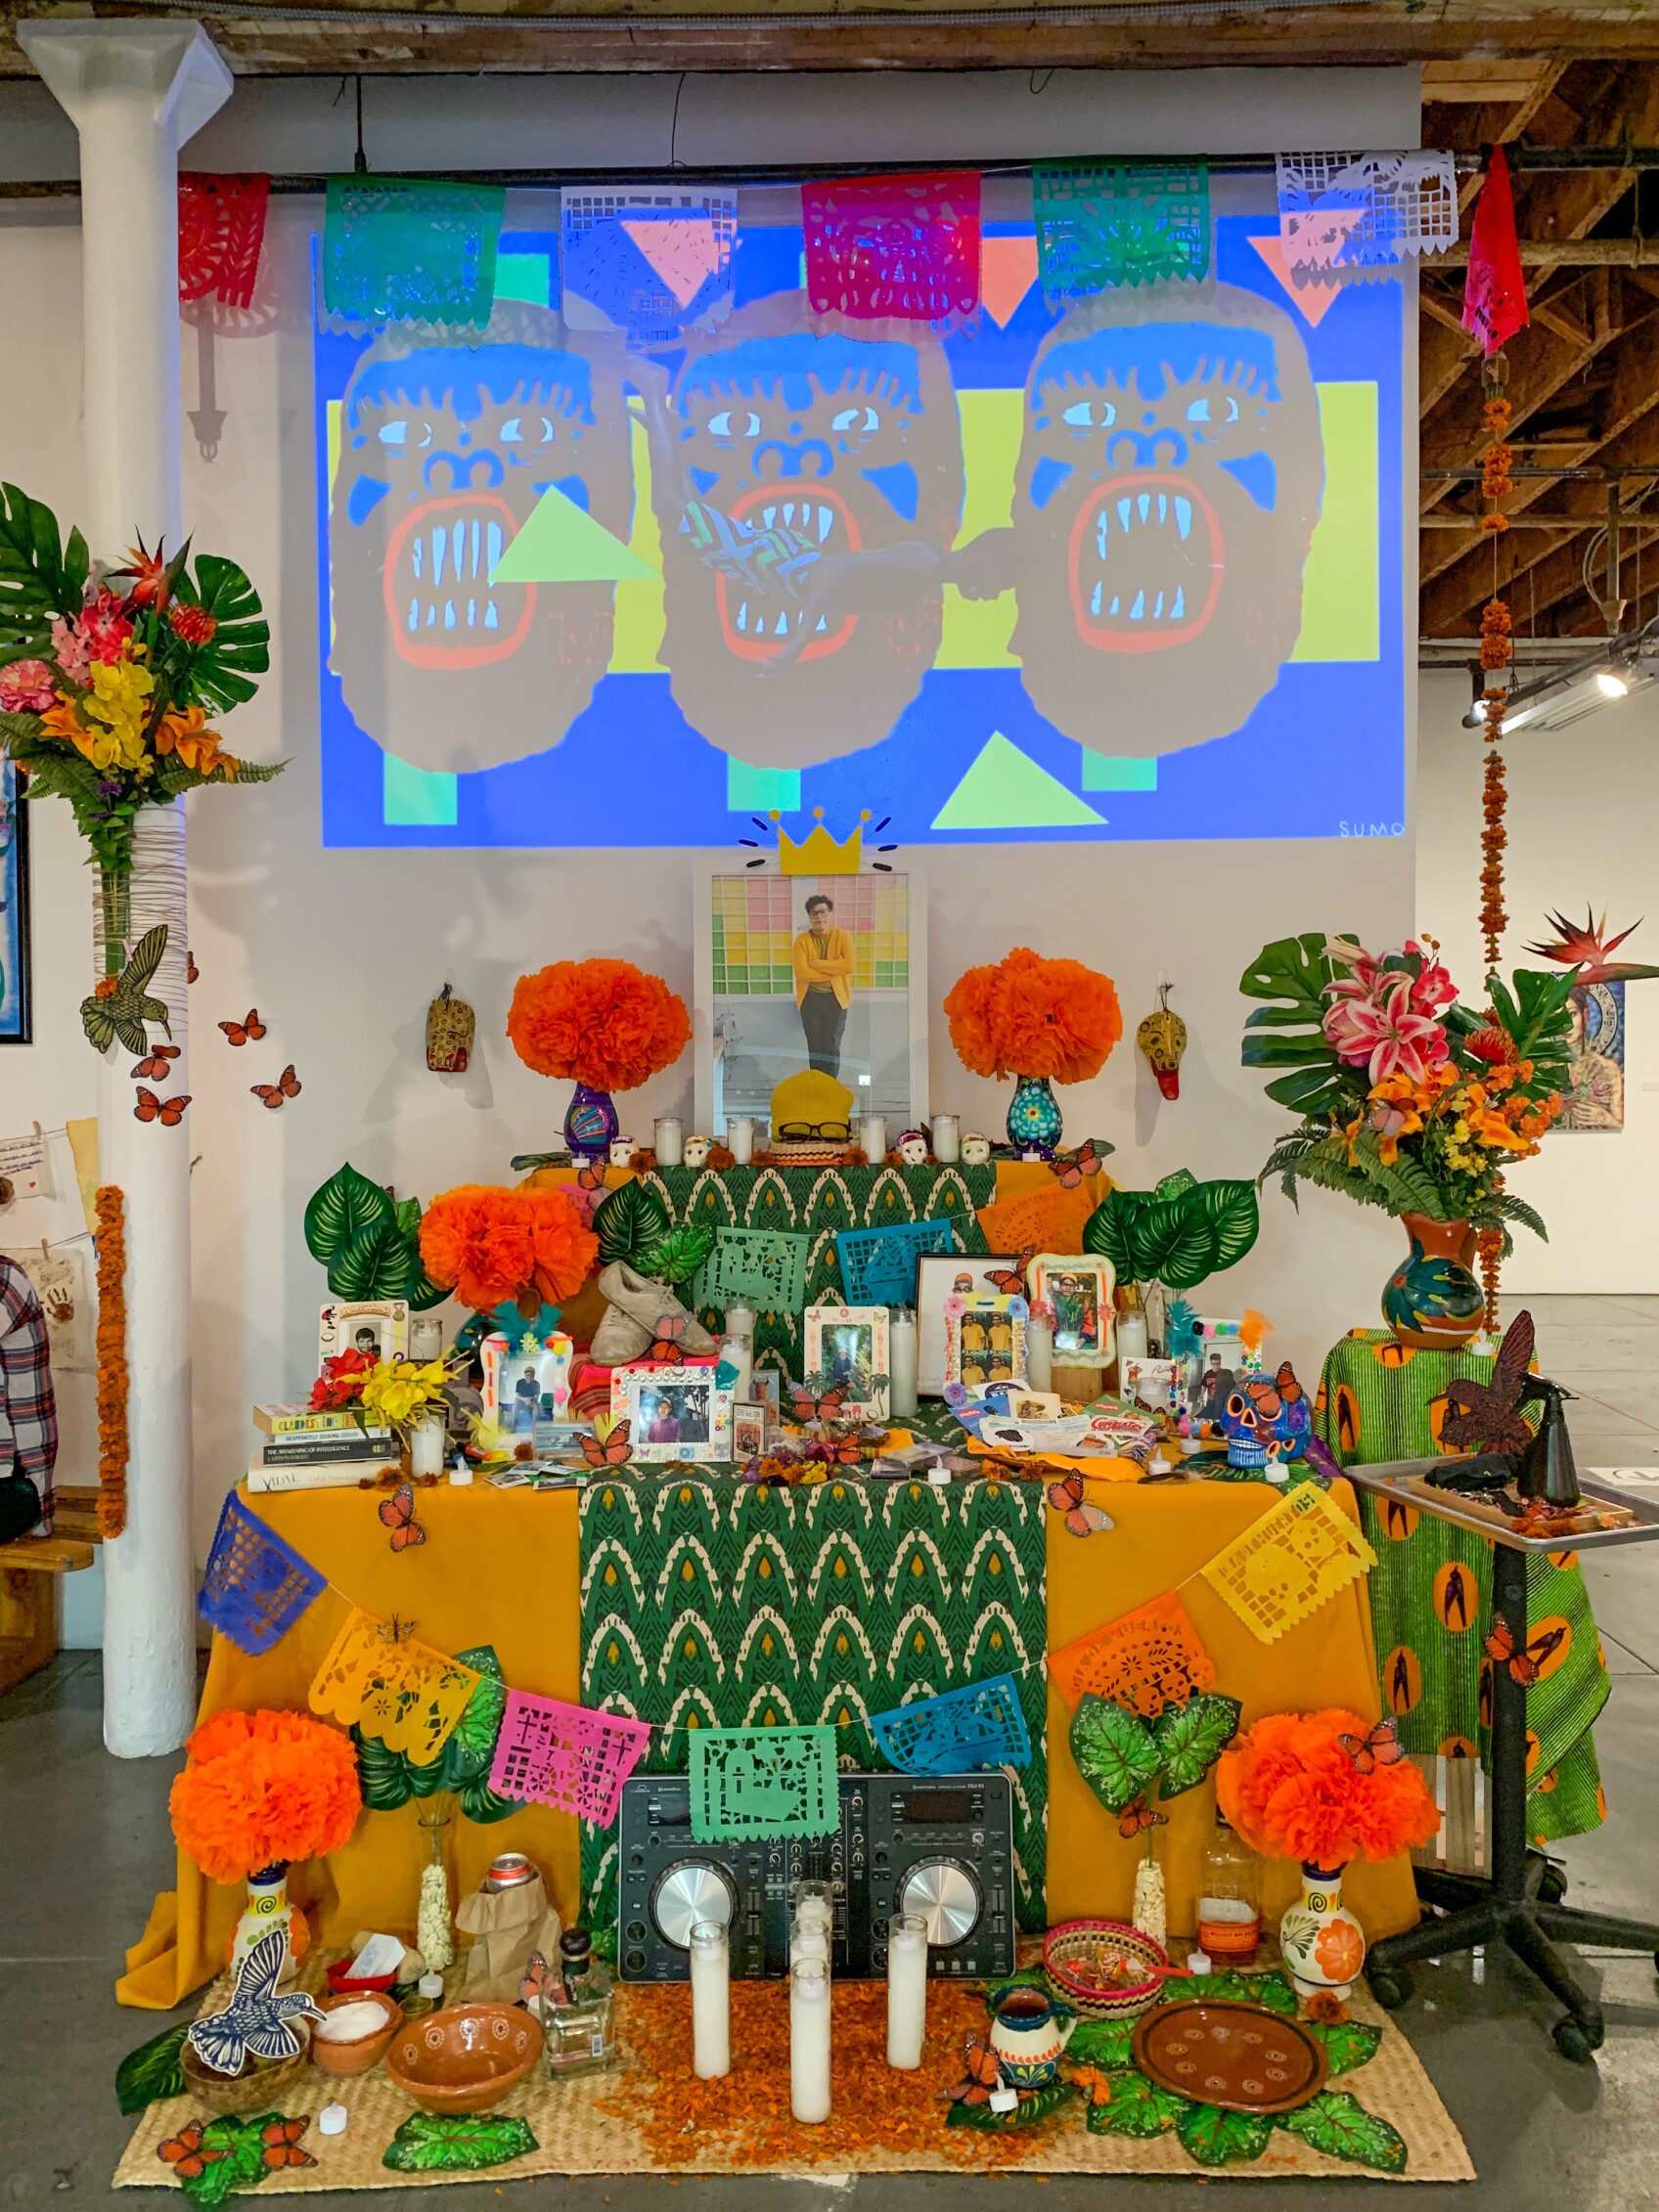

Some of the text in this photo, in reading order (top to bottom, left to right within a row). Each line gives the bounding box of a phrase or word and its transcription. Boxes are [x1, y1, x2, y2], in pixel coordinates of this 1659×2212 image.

[1339, 820, 1405, 837] SUMO
[279, 1416, 338, 1431] CLANDESTINO
[263, 1474, 296, 1491] VIDAL
